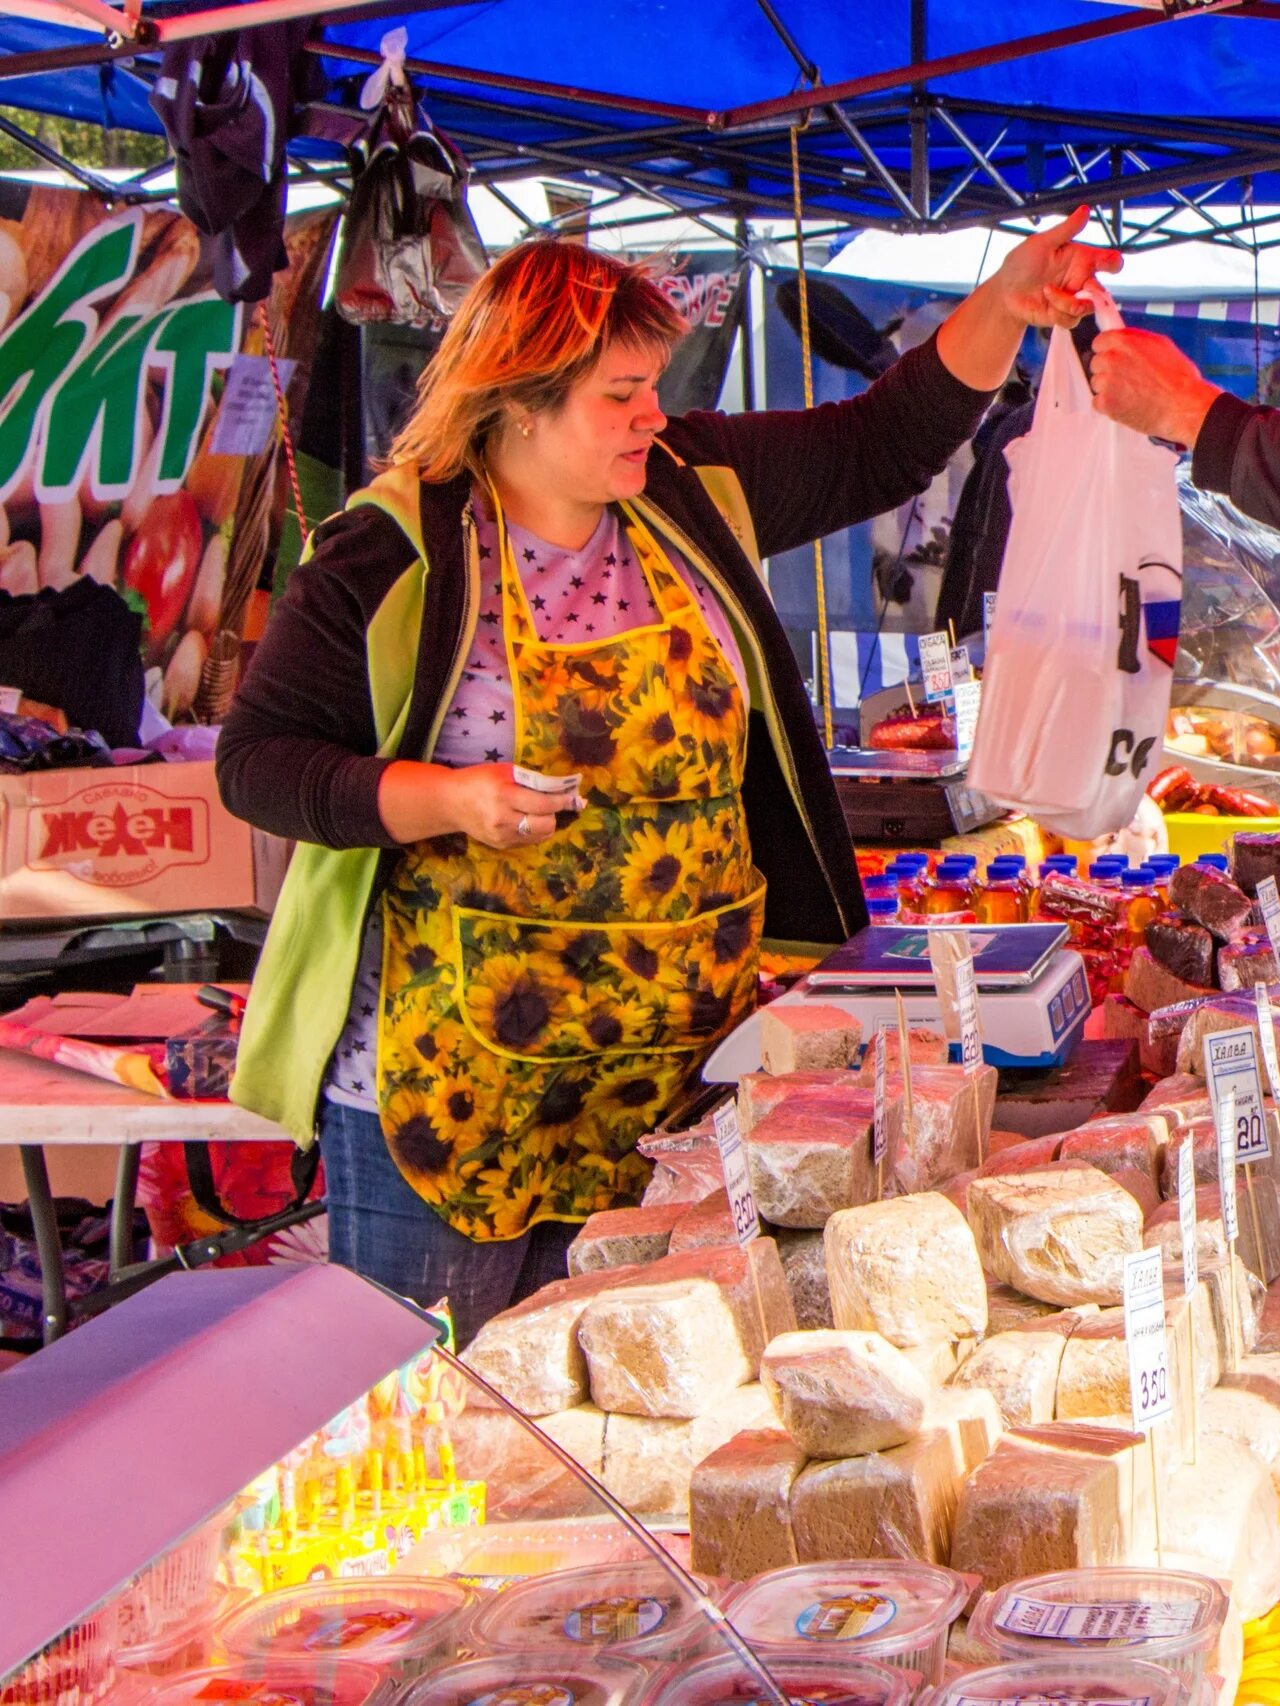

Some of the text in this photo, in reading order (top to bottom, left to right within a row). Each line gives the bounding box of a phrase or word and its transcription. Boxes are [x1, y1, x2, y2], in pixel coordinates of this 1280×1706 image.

[1237, 1115, 1261, 1149] 20
[734, 1192, 755, 1235] 250
[1140, 1366, 1166, 1410] 350
